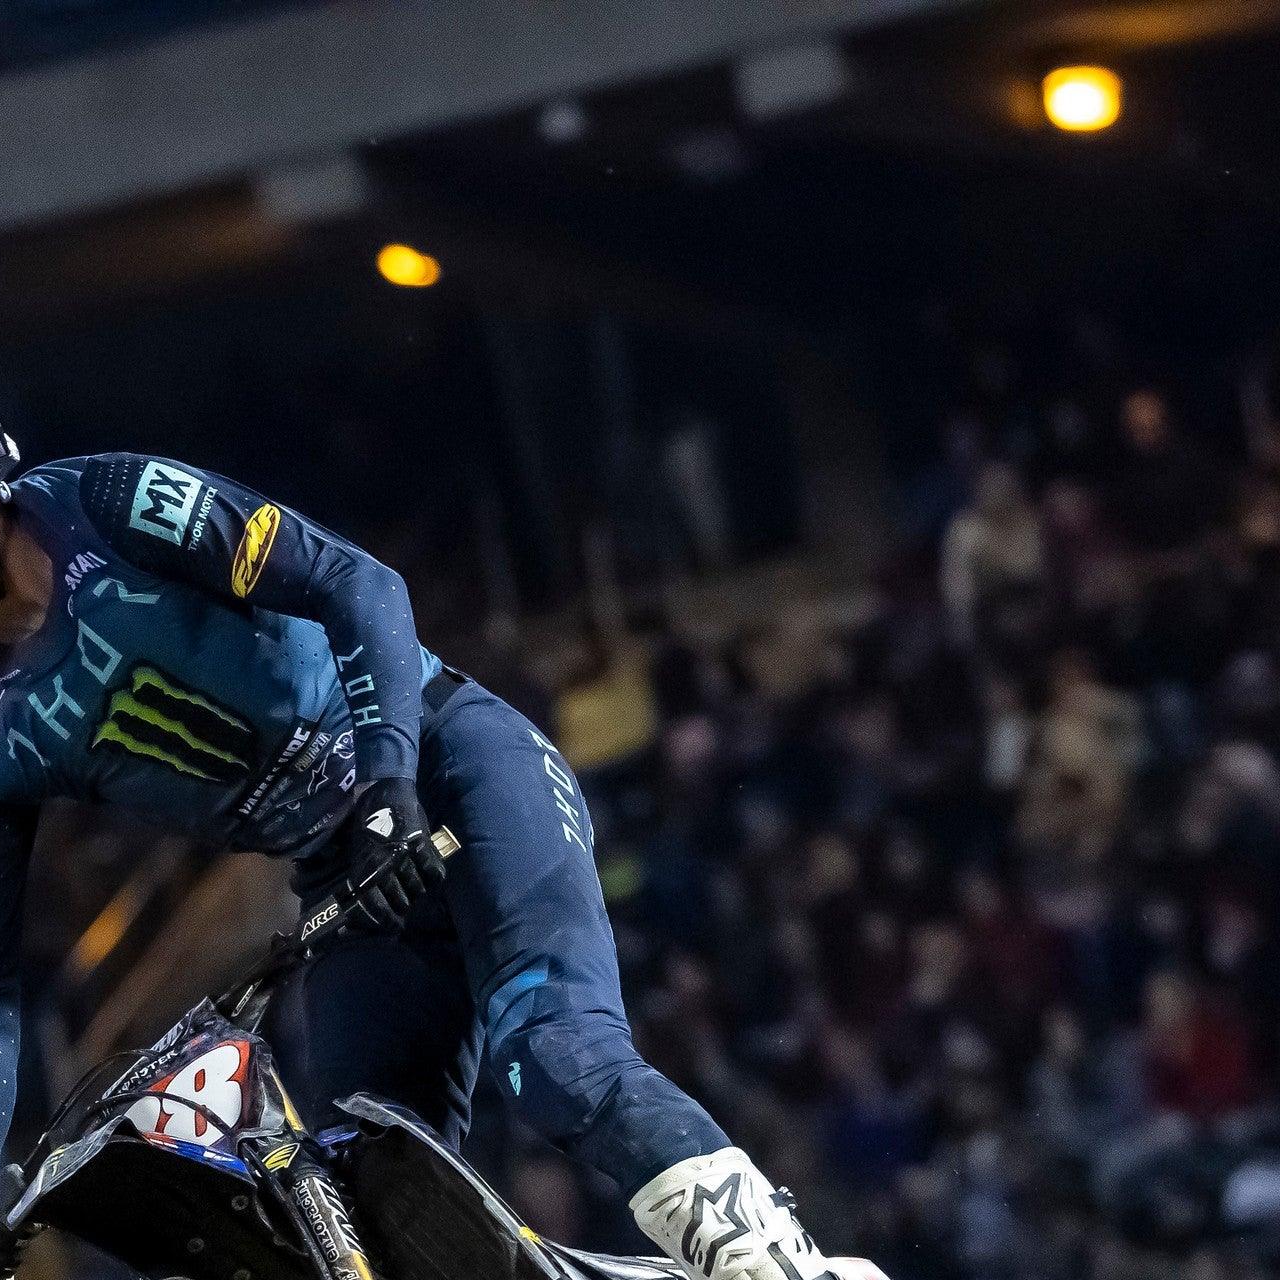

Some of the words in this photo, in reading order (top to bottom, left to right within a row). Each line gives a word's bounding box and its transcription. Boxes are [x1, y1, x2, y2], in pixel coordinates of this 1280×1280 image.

[139, 467, 192, 531] MX
[187, 520, 206, 551] THOR
[232, 503, 279, 597] FMF
[337, 645, 382, 727] HOR
[300, 903, 338, 941] ARC
[119, 1050, 179, 1093] ONSTER
